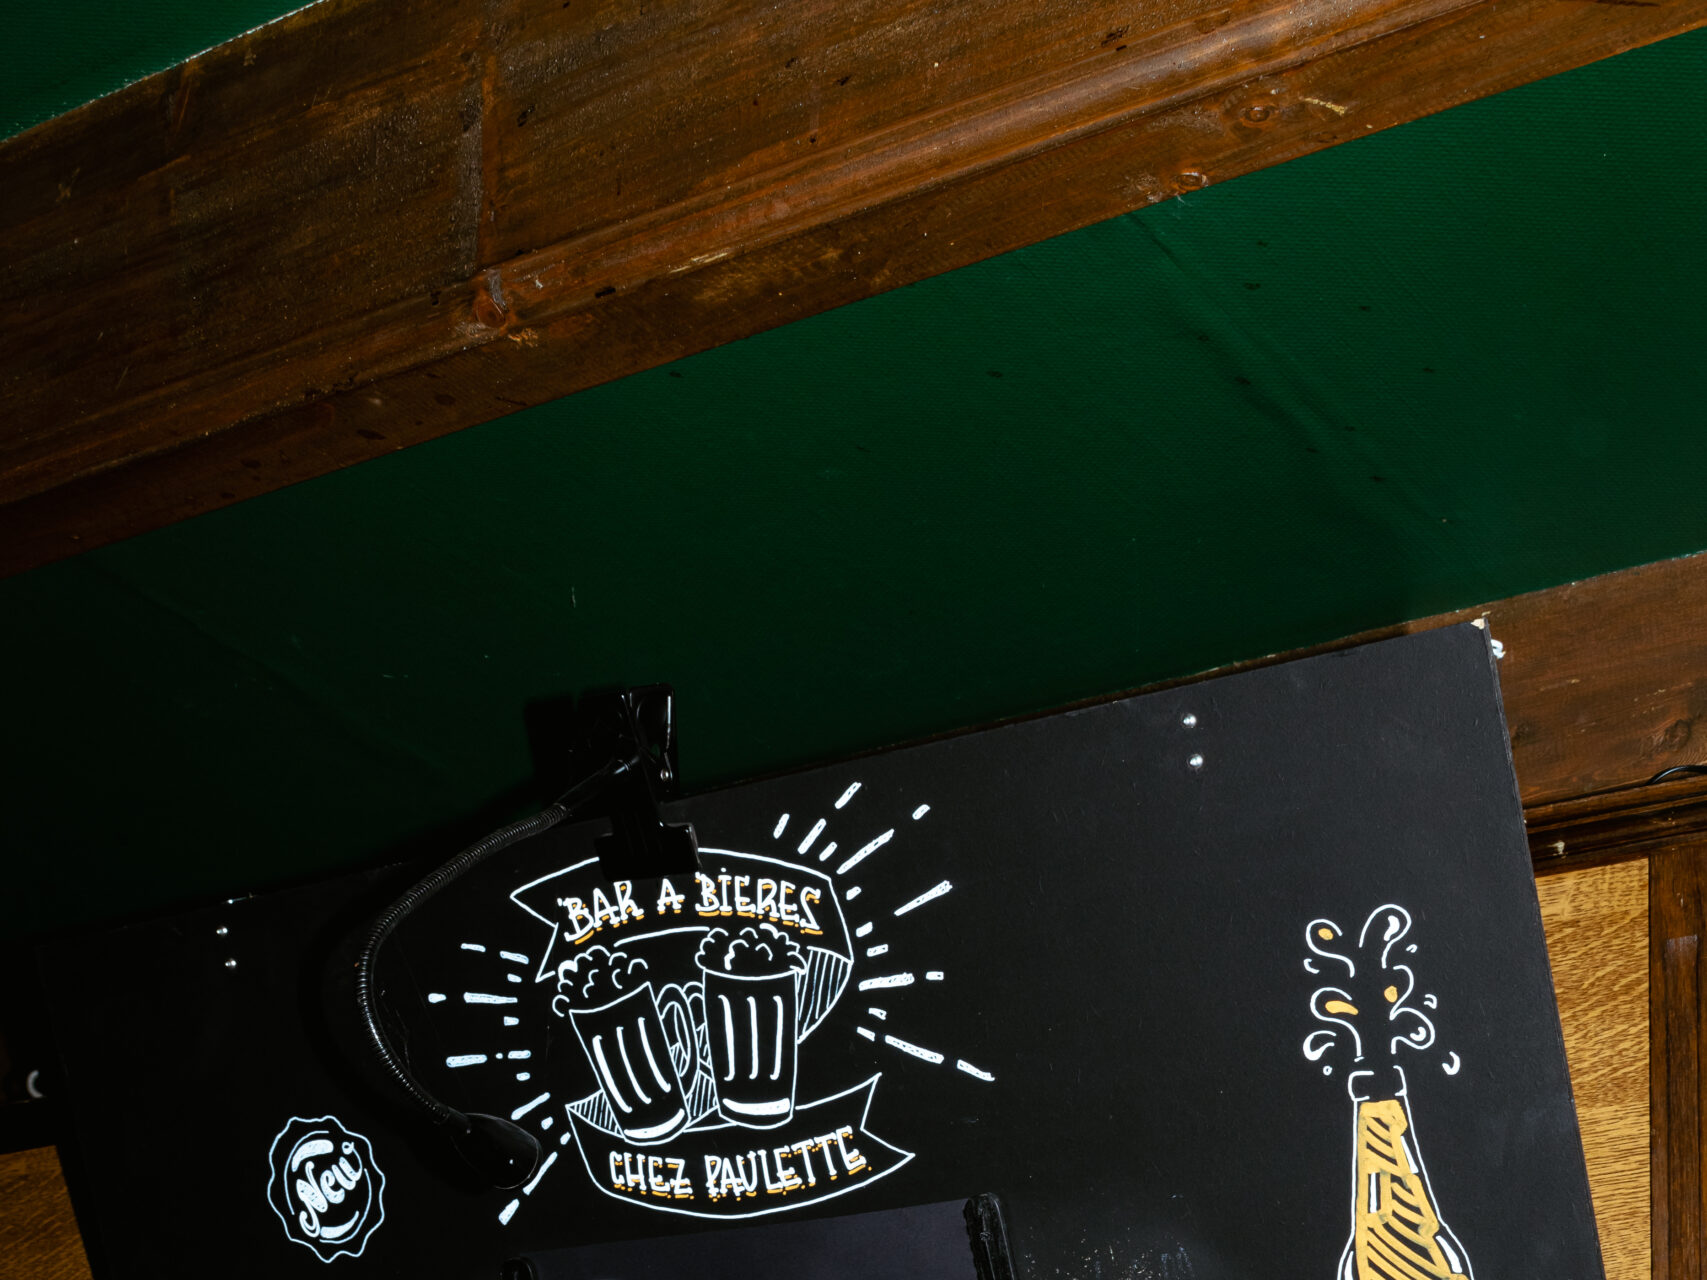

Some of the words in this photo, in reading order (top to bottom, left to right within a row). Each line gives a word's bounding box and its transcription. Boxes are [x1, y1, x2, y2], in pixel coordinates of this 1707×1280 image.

[557, 880, 643, 943] BAR
[657, 878, 685, 914] A
[694, 867, 824, 935] BIERES
[609, 1151, 694, 1200] CHEZ
[704, 1126, 872, 1202] PAULETTE
